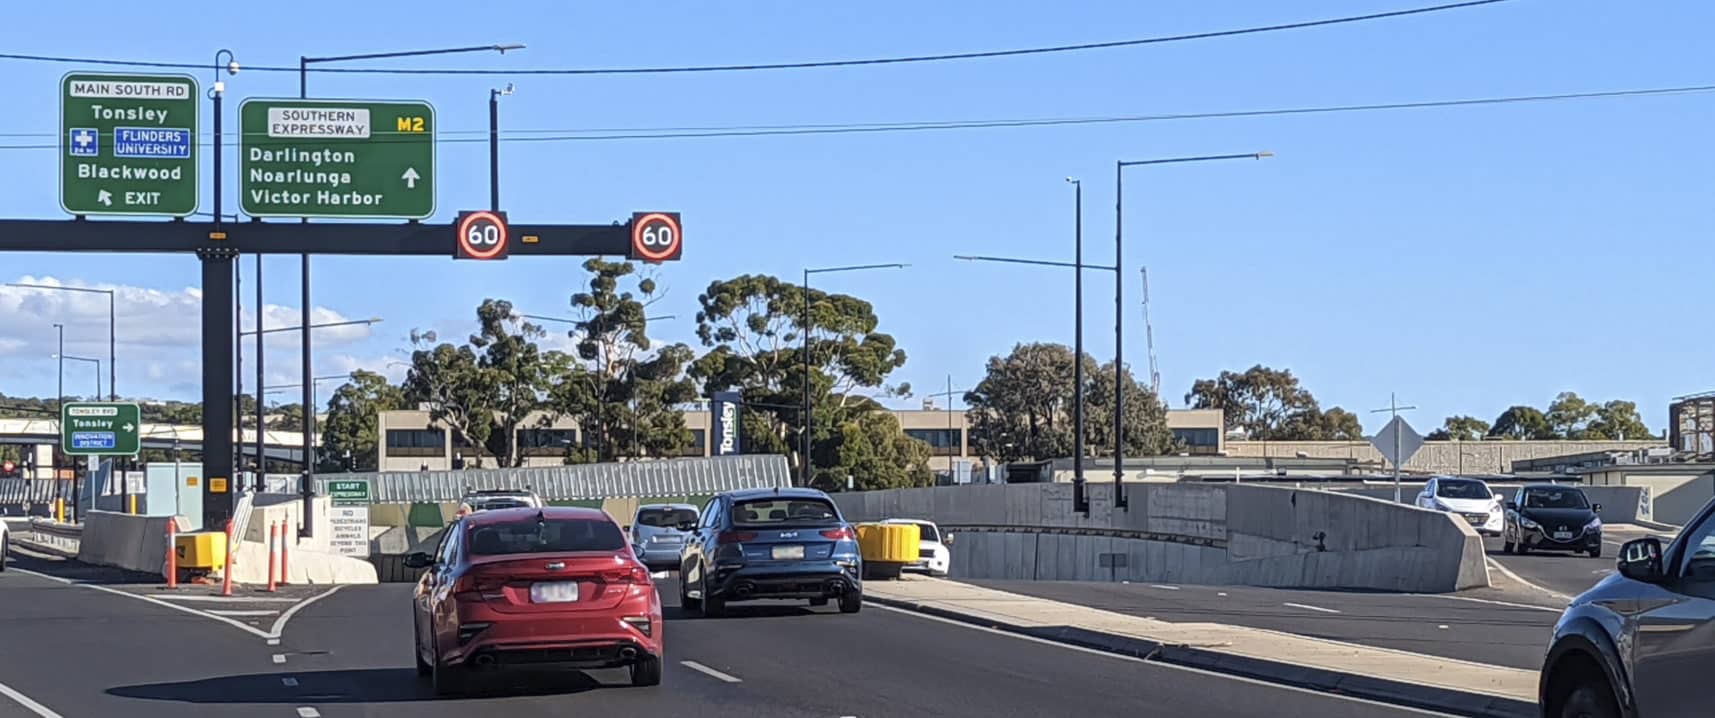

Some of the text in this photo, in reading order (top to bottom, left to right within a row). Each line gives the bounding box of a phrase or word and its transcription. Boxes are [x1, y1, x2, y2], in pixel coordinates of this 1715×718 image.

[74, 83, 184, 97] MAIN SOUTH RD
[91, 105, 168, 124] Tonsley
[282, 110, 355, 122] SOUTHERN
[272, 123, 364, 135] EXPRESSWAY
[397, 117, 425, 132] M2
[122, 130, 181, 142] FLINDERS
[117, 142, 187, 155] UNIVERSITY
[250, 147, 355, 166] Darlington
[78, 163, 181, 180] Blackwood
[250, 168, 351, 187] Noarlunga
[125, 191, 160, 205] EXIT
[250, 189, 383, 205] Victor Harbor
[468, 225, 498, 245] 60
[642, 226, 672, 246] 60
[73, 418, 113, 429] Tonsley
[720, 401, 736, 455] Tonsley
